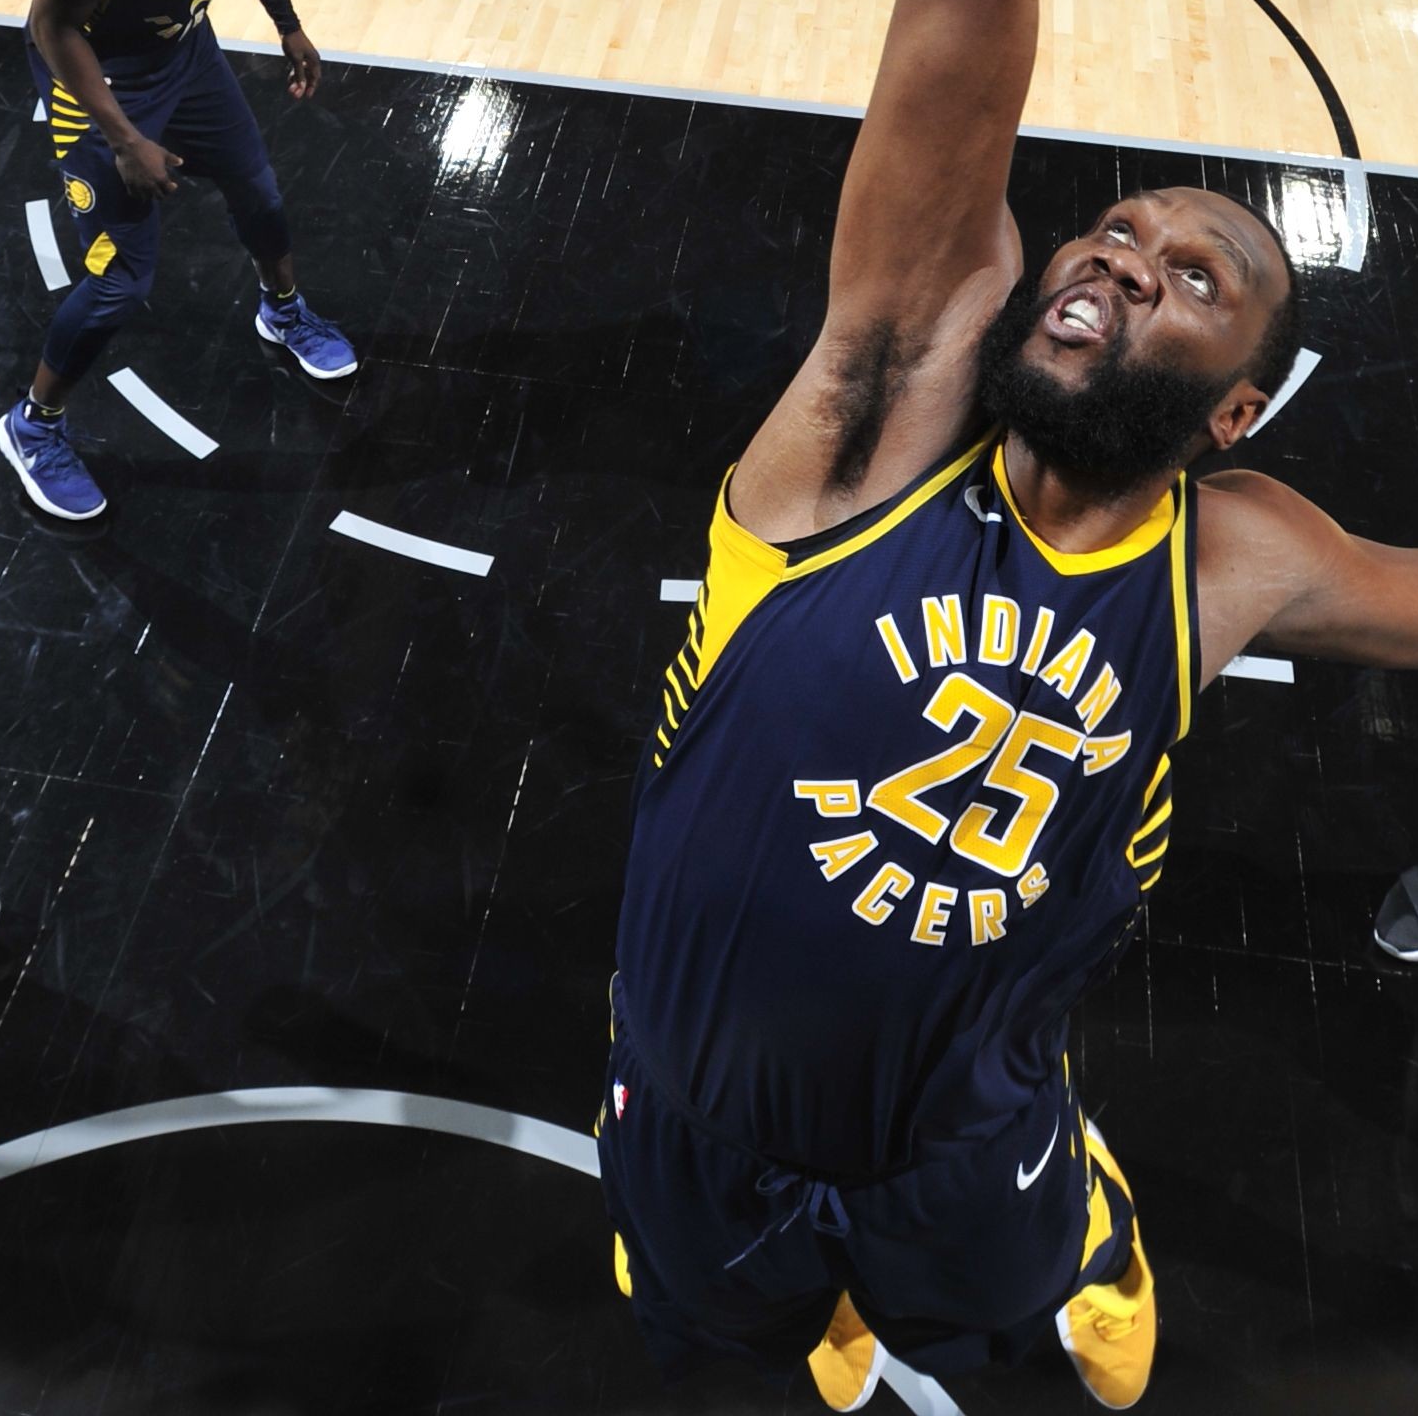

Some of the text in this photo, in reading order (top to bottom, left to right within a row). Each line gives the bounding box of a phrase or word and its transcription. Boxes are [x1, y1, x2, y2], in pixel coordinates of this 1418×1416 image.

[865, 671, 1087, 878] 25
[875, 593, 1132, 776] INDIANA
[792, 778, 1051, 947] PACERS
